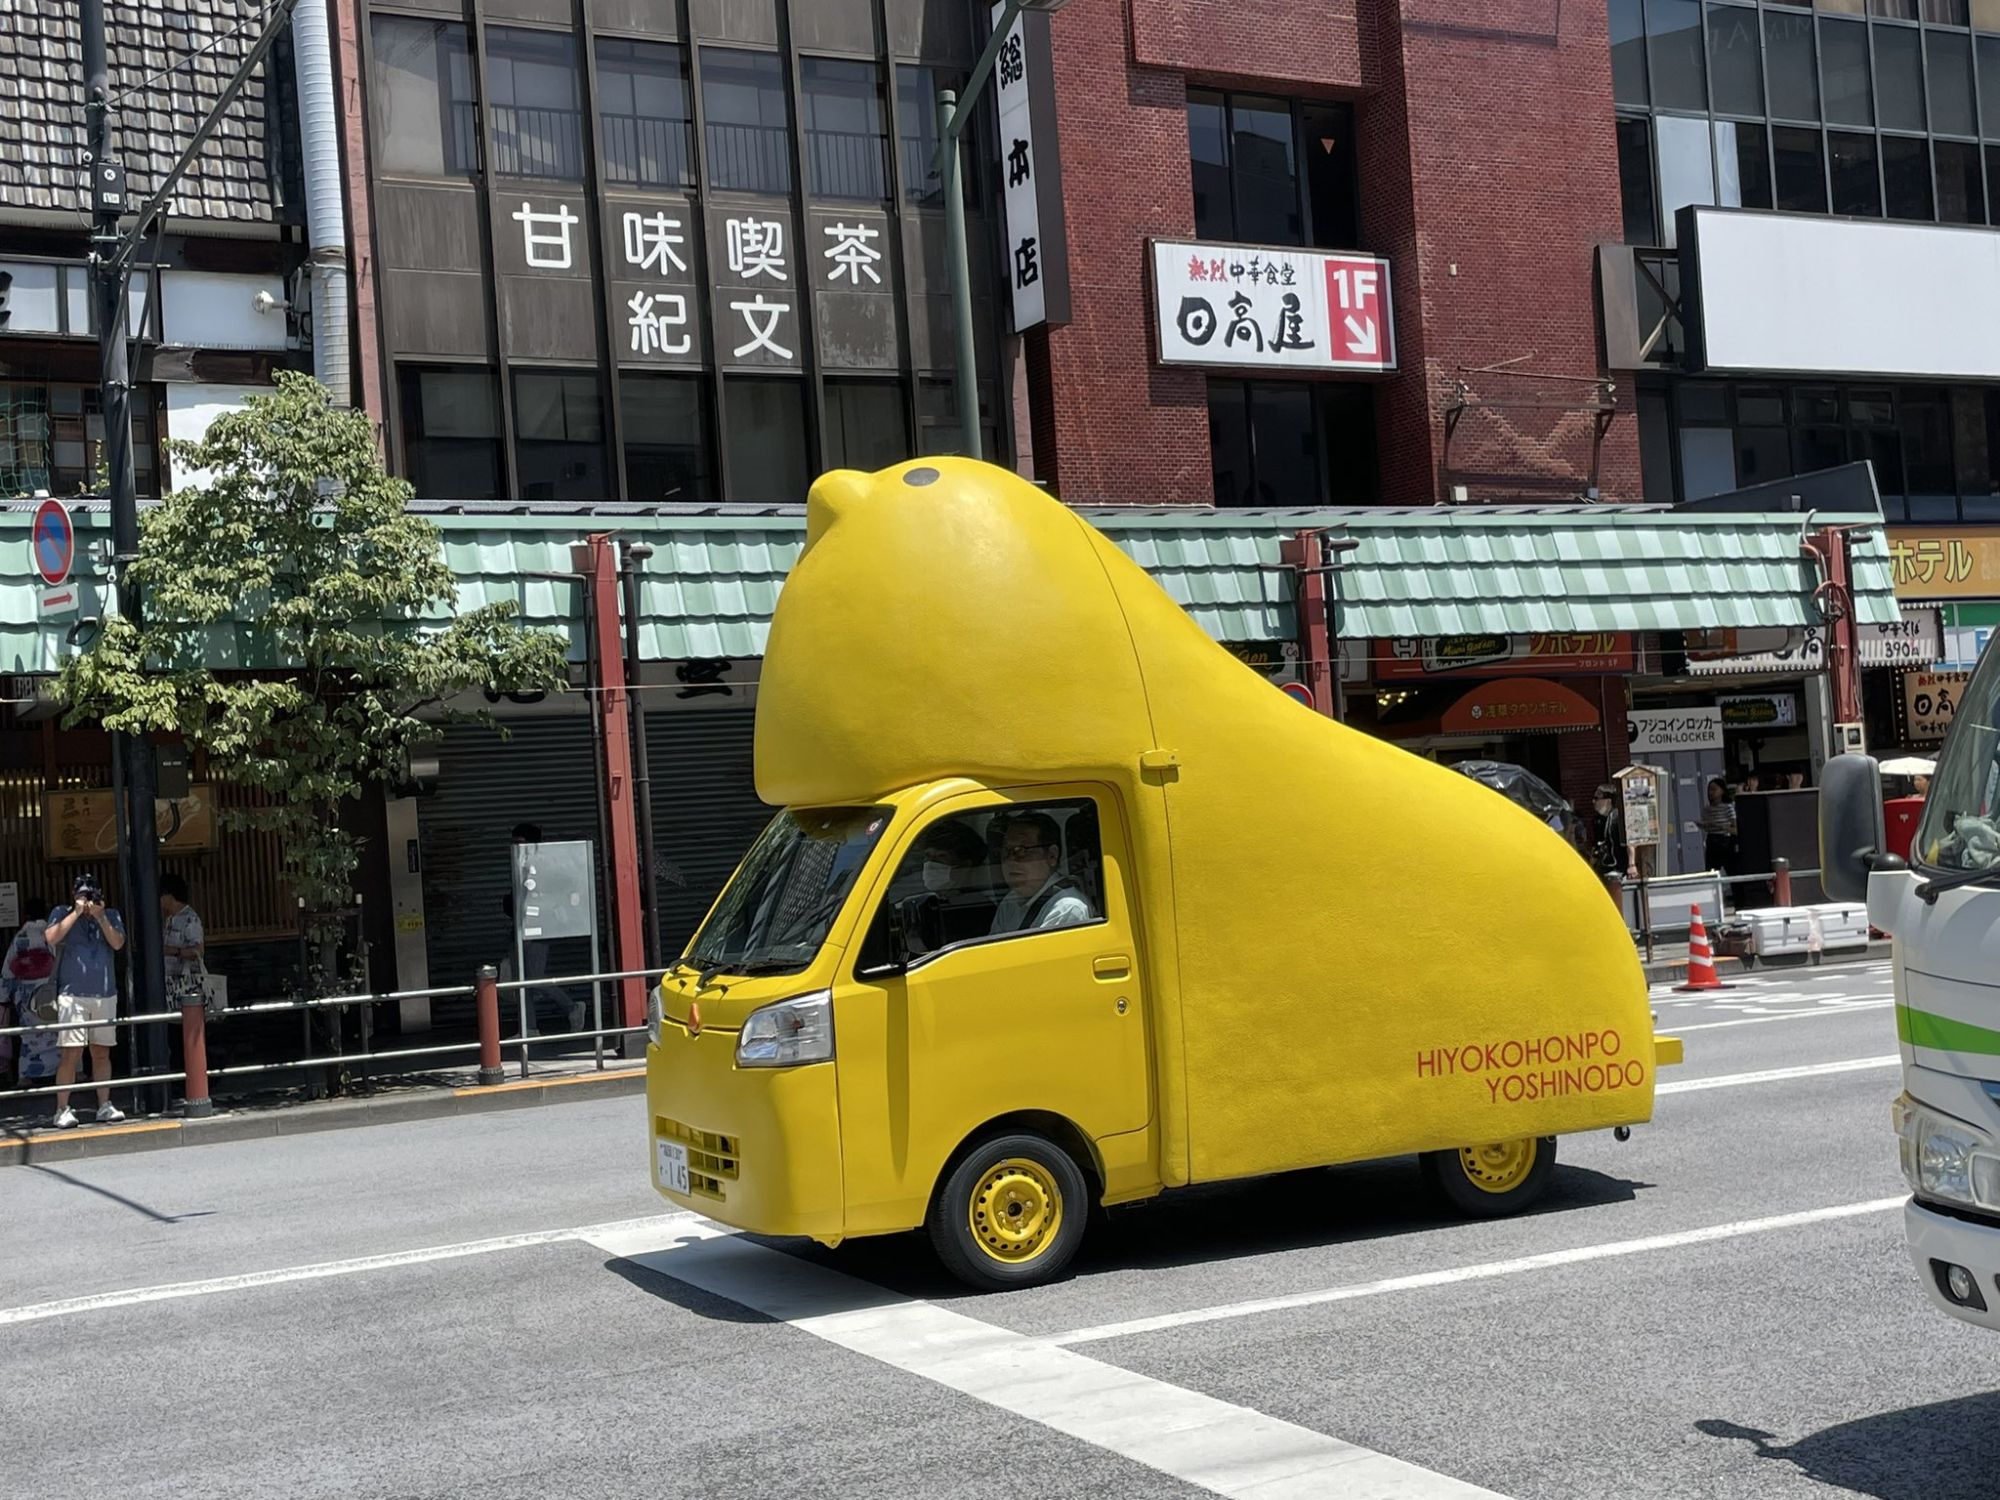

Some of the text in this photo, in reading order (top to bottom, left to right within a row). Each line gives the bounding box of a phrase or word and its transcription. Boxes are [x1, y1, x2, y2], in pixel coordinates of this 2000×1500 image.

[512, 202, 882, 285] 甘味喫茶
[1188, 254, 1297, 286] 熱烈中華食堂
[1333, 268, 1379, 310] 1F
[628, 290, 793, 360] 紀文
[1177, 290, 1316, 353] 日高屋
[1891, 540, 1973, 584] ホテル
[1649, 731, 1716, 744] COIN-LOCKER
[1417, 1029, 1620, 1078] HIYOKOHONPO
[1485, 1060, 1644, 1104] YOSHINODO
